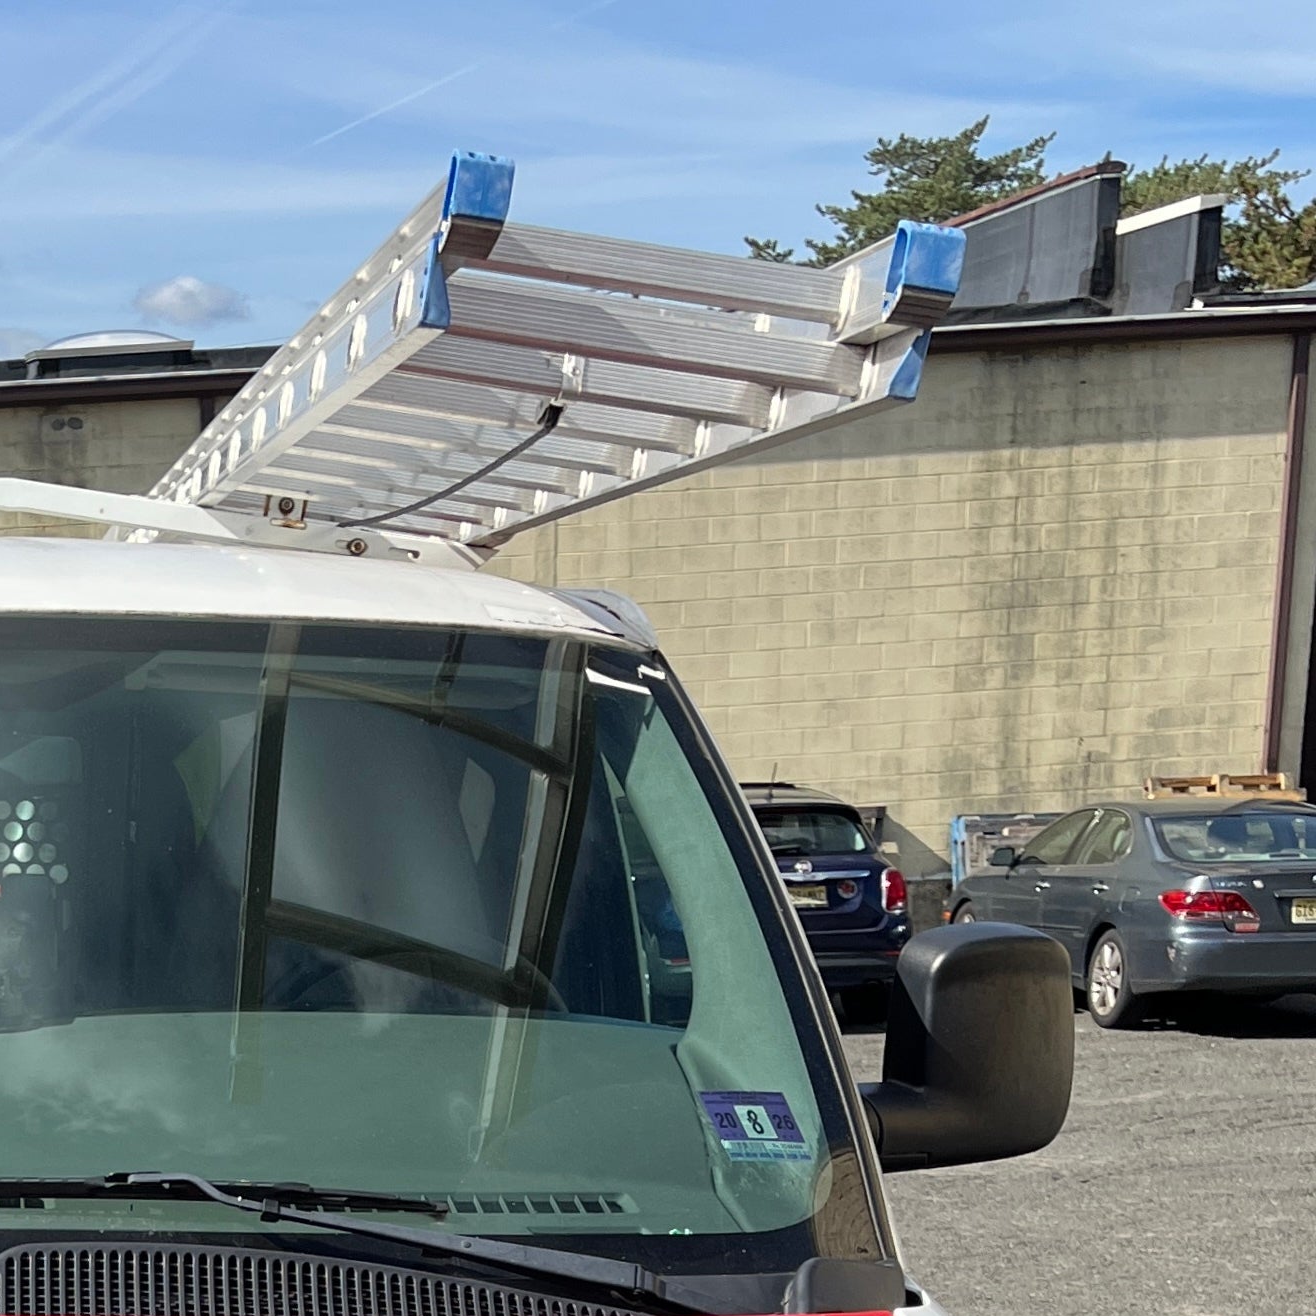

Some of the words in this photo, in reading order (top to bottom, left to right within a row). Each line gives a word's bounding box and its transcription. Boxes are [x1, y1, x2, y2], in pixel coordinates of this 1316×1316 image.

[714, 1112, 737, 1129] 20
[746, 1109, 765, 1135] 8
[771, 1113, 795, 1131] 26
